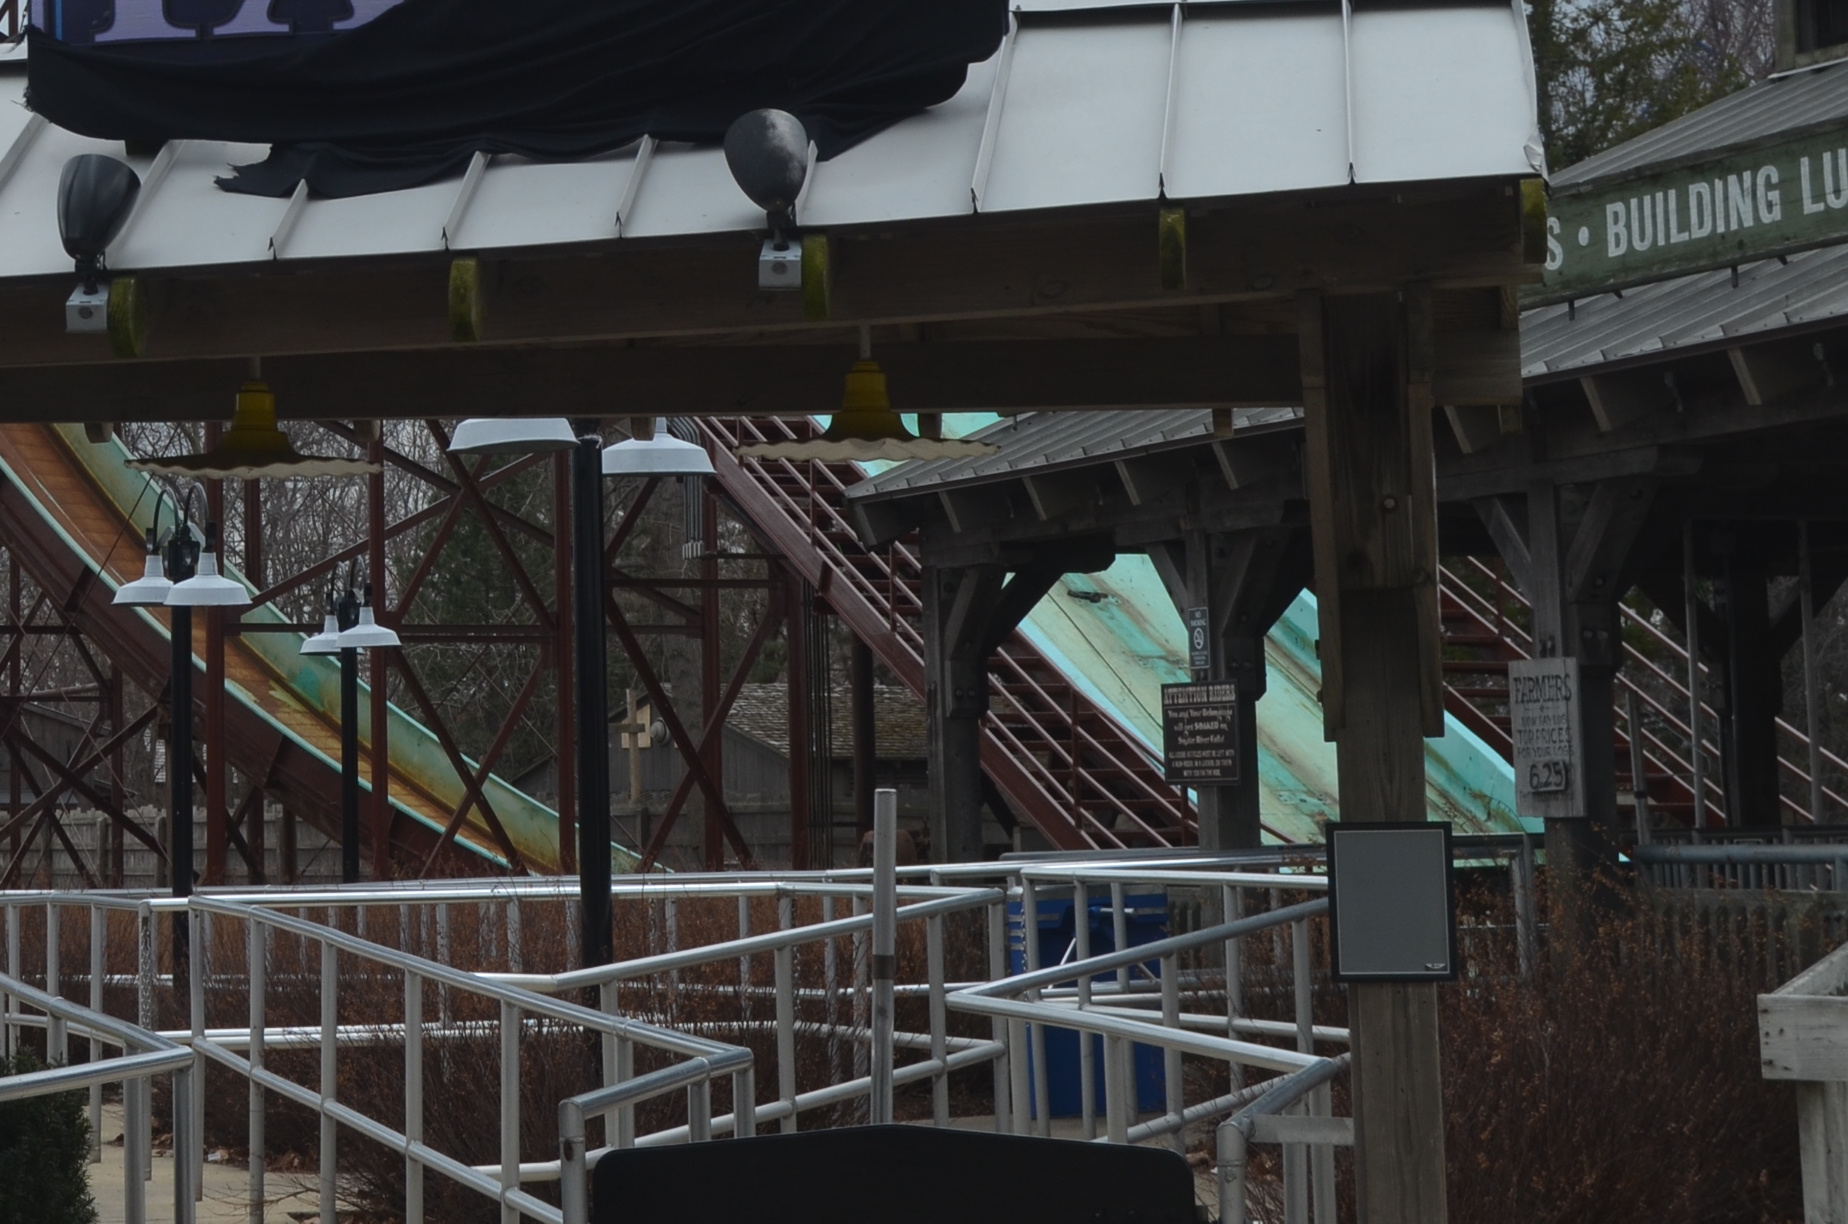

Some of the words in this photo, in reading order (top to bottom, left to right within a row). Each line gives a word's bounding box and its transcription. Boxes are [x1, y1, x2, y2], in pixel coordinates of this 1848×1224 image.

[1606, 164, 1782, 258] BUILDING
[1800, 148, 1848, 216] LU
[1209, 684, 1236, 702] RIDERS
[1513, 675, 1572, 704] FARMERS
[1517, 730, 1534, 744] TOP
[1536, 727, 1573, 744] PRICES
